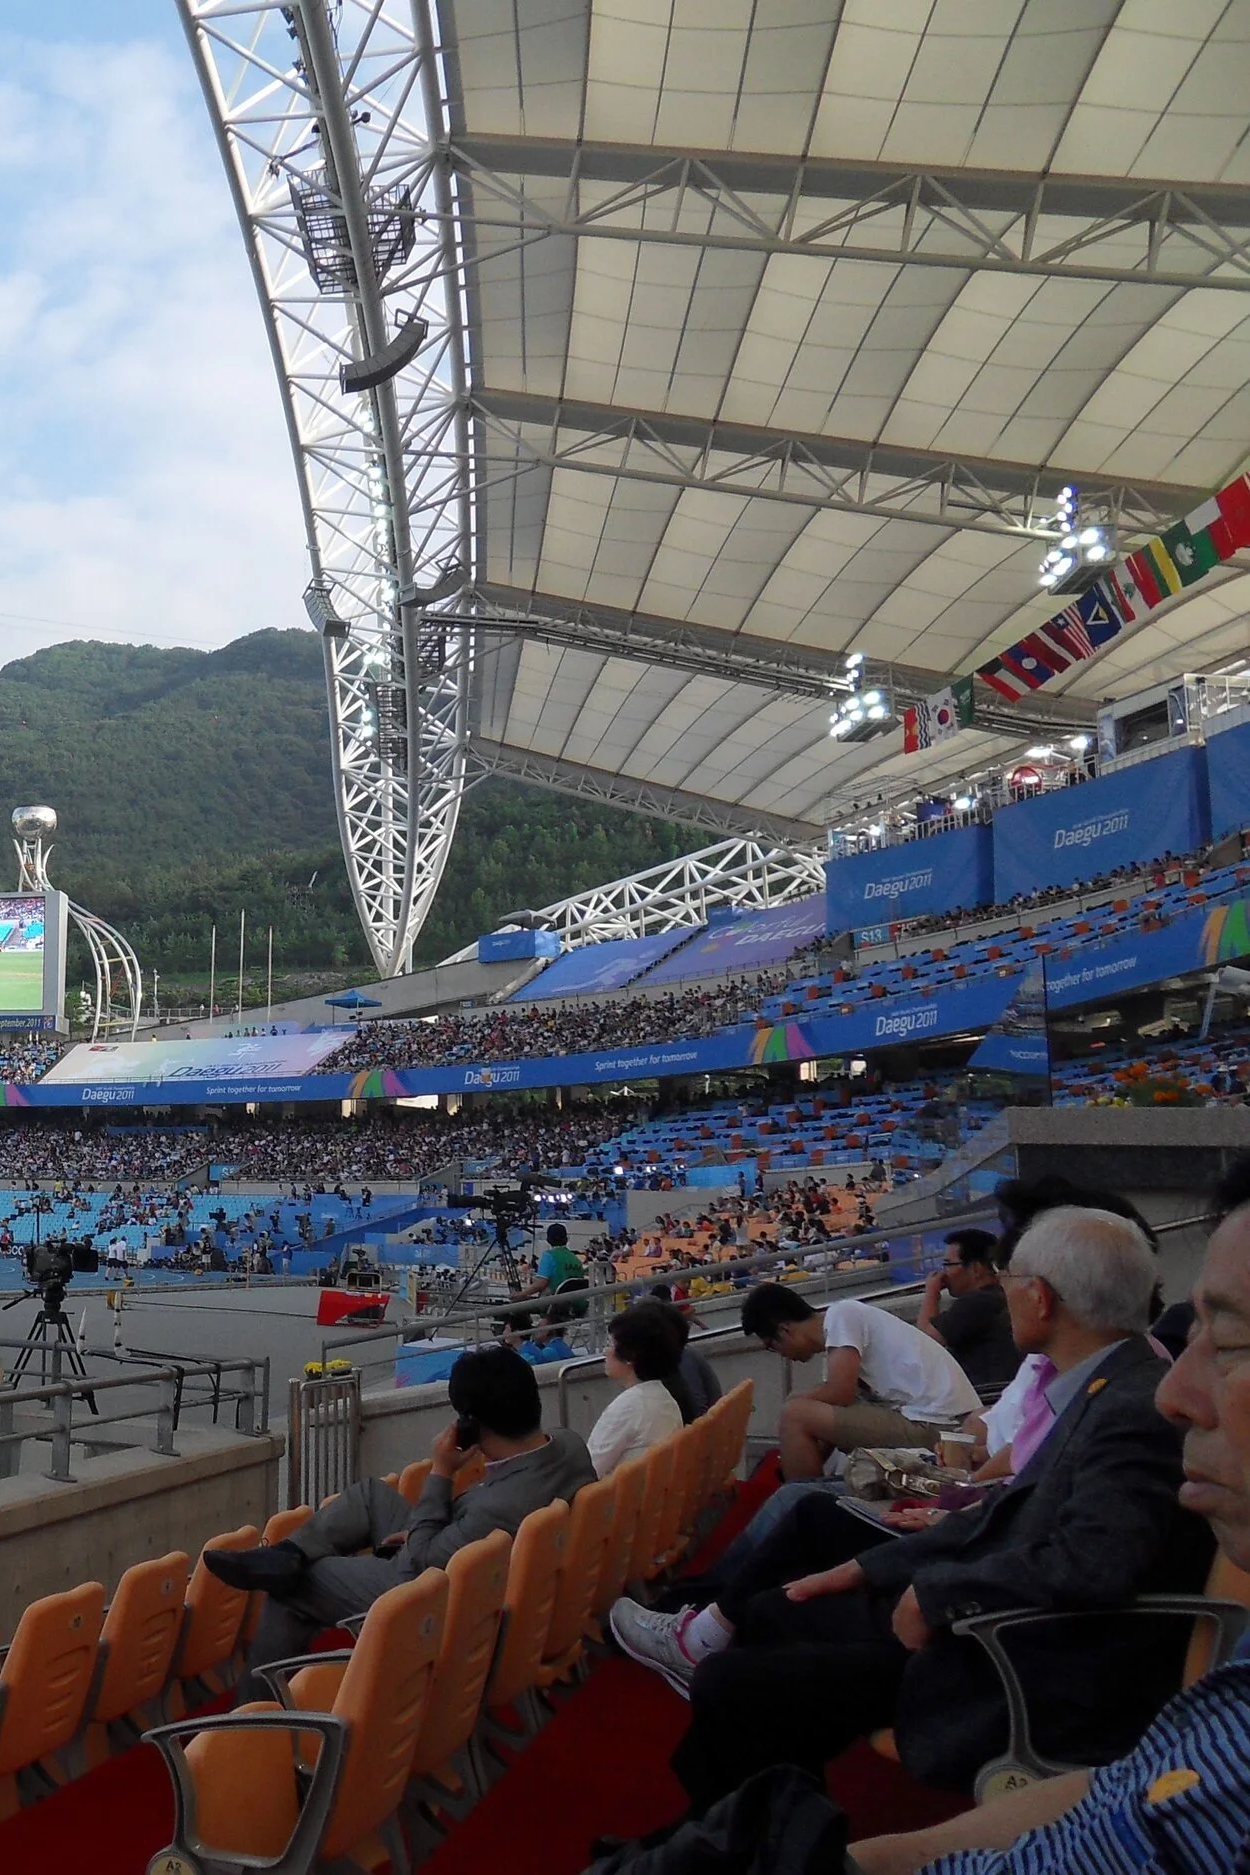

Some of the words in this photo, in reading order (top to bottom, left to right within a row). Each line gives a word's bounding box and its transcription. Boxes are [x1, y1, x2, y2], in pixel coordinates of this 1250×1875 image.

[1053, 823, 1101, 848] Daegu
[1102, 815, 1129, 835] 2011
[863, 880, 909, 899] Daegu
[909, 874, 932, 890] 2011
[861, 928, 882, 943] S13
[1081, 967, 1094, 982] for
[1095, 956, 1138, 978] tomorrow
[875, 1015, 916, 1037] Daegu
[915, 1010, 938, 1028] 2011
[595, 1060, 616, 1072] Sprint
[617, 1057, 648, 1069] together
[649, 1054, 660, 1064] for
[661, 1052, 698, 1063] tomorrow
[500, 1071, 520, 1082] 2011
[82, 1088, 116, 1103] Daegu
[116, 1090, 135, 1101] 2011
[206, 1086, 226, 1095] Sprint
[227, 1086, 256, 1094] together
[268, 1084, 302, 1093] tomorrow
